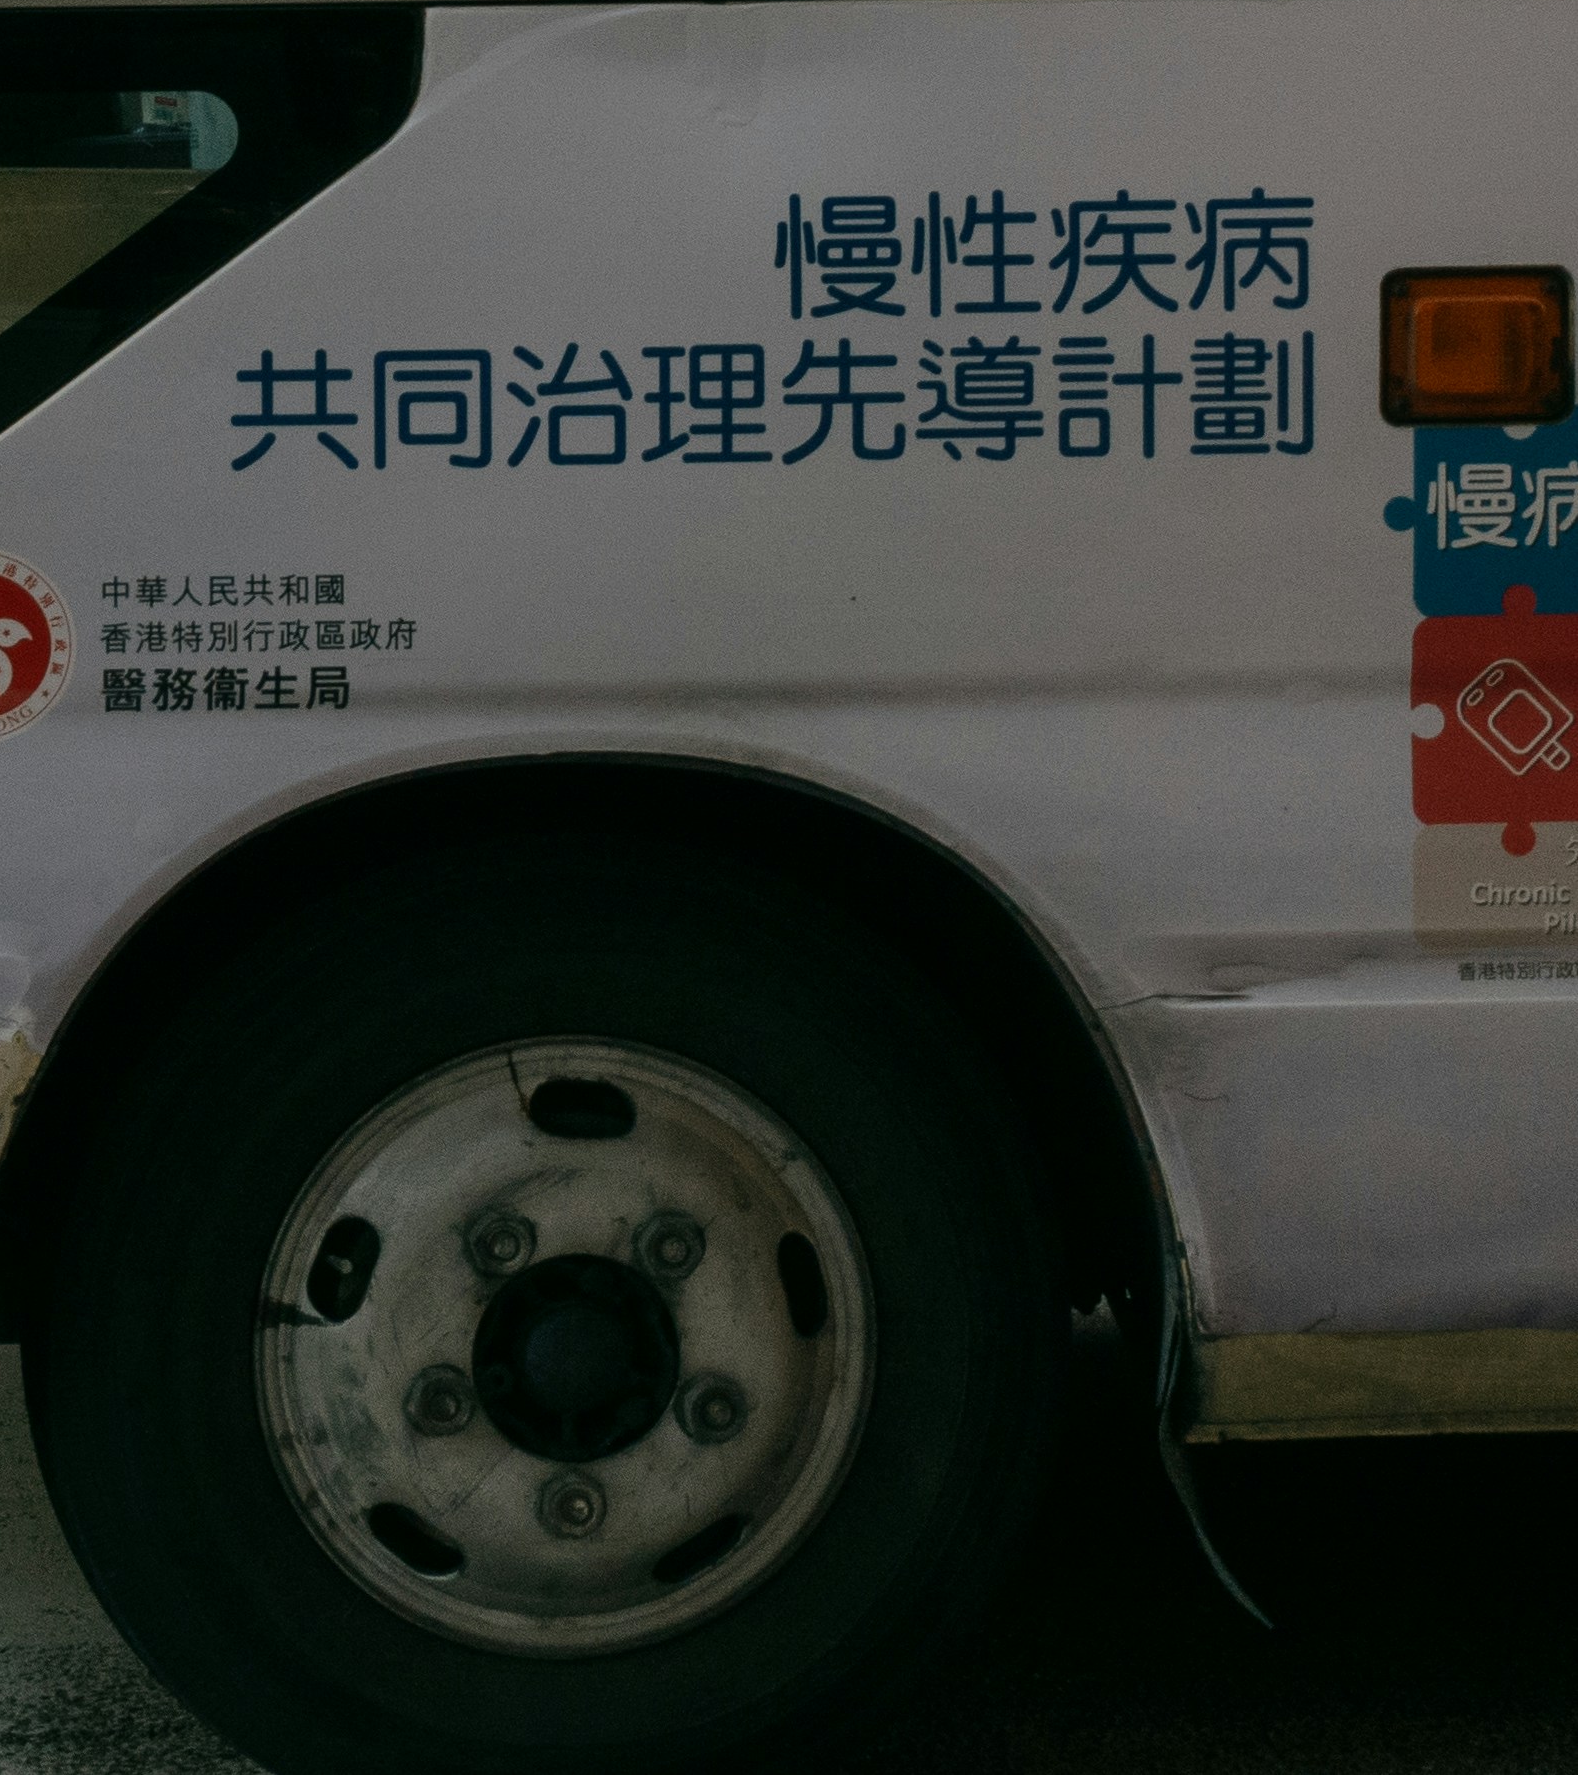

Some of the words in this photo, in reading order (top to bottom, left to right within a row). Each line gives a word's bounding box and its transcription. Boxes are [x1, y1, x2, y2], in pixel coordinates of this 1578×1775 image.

[774, 188, 1315, 319] 慢性疾病
[230, 330, 1315, 471] 共同治理先導計劃
[101, 574, 346, 609] 中華人民共和國
[100, 617, 418, 656] 香港特別行政區政府
[1470, 878, 1572, 906] Chronic
[1544, 911, 1578, 935] Pil
[1458, 961, 1578, 982] 香港特別行政
